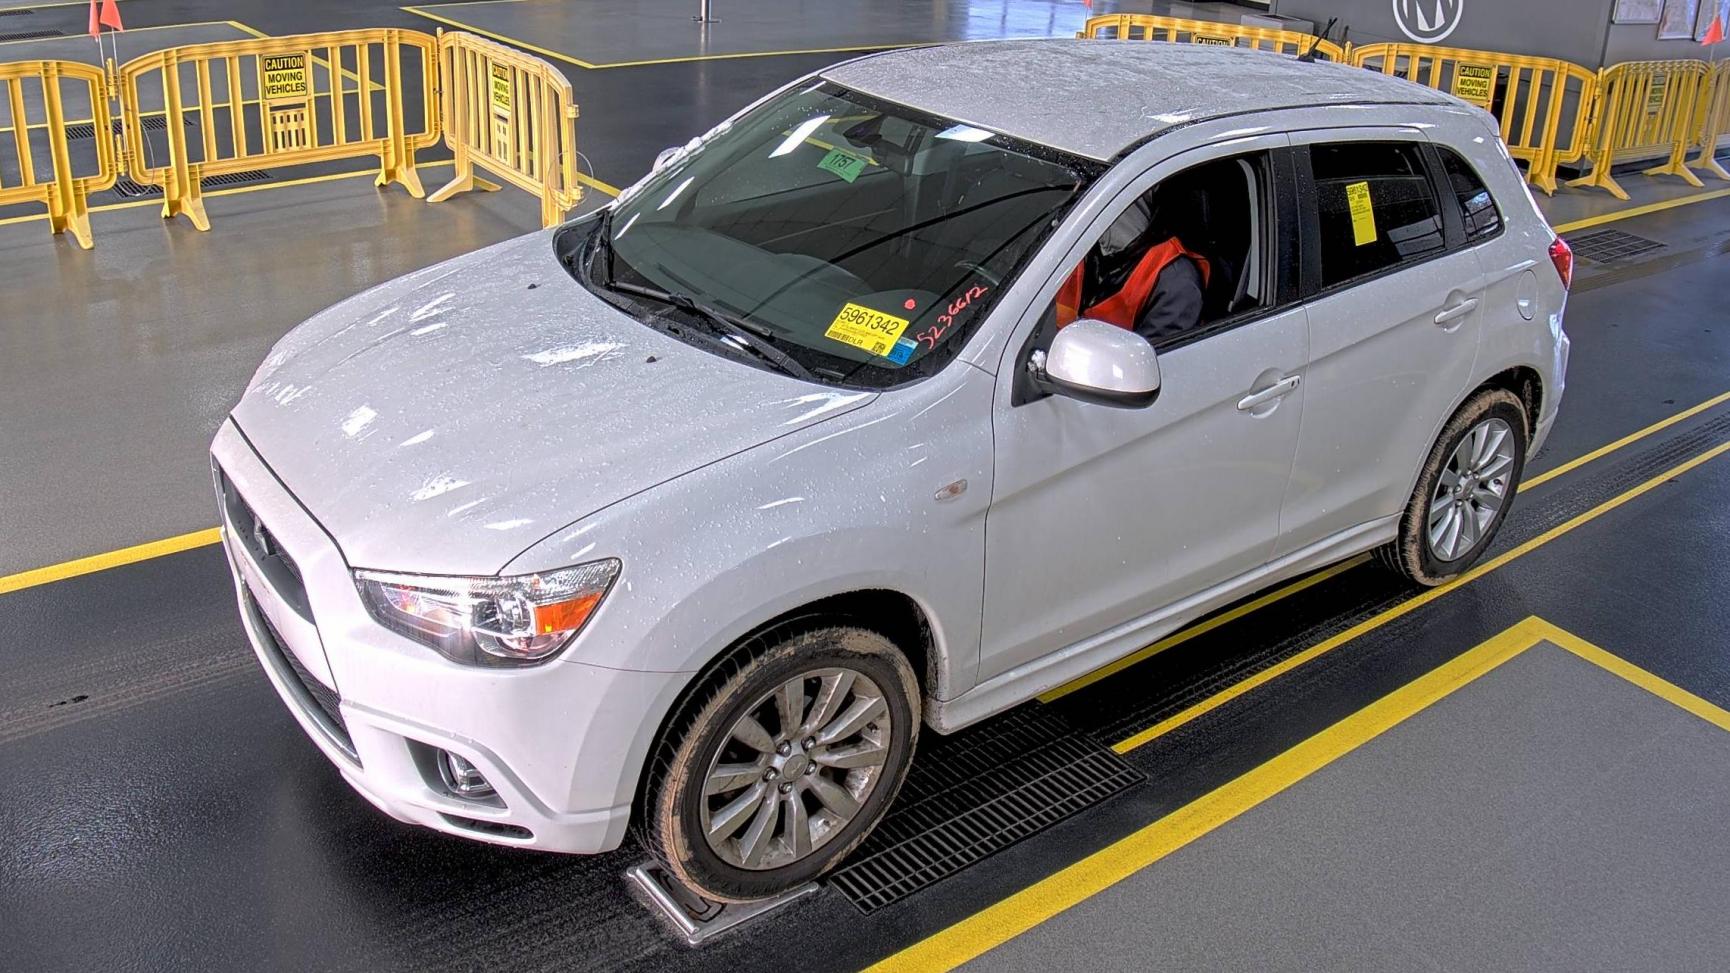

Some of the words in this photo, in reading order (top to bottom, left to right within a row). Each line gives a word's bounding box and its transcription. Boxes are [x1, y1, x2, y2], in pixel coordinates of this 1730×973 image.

[265, 57, 304, 70] CAUTION
[268, 71, 303, 84] MOVING
[1460, 66, 1490, 77] CAUTION
[265, 82, 306, 95] VEHICLES
[1460, 78, 1488, 88] MOVING
[1457, 87, 1488, 97] VEHICLES
[830, 153, 855, 169] 1757
[839, 307, 900, 336] 5961342
